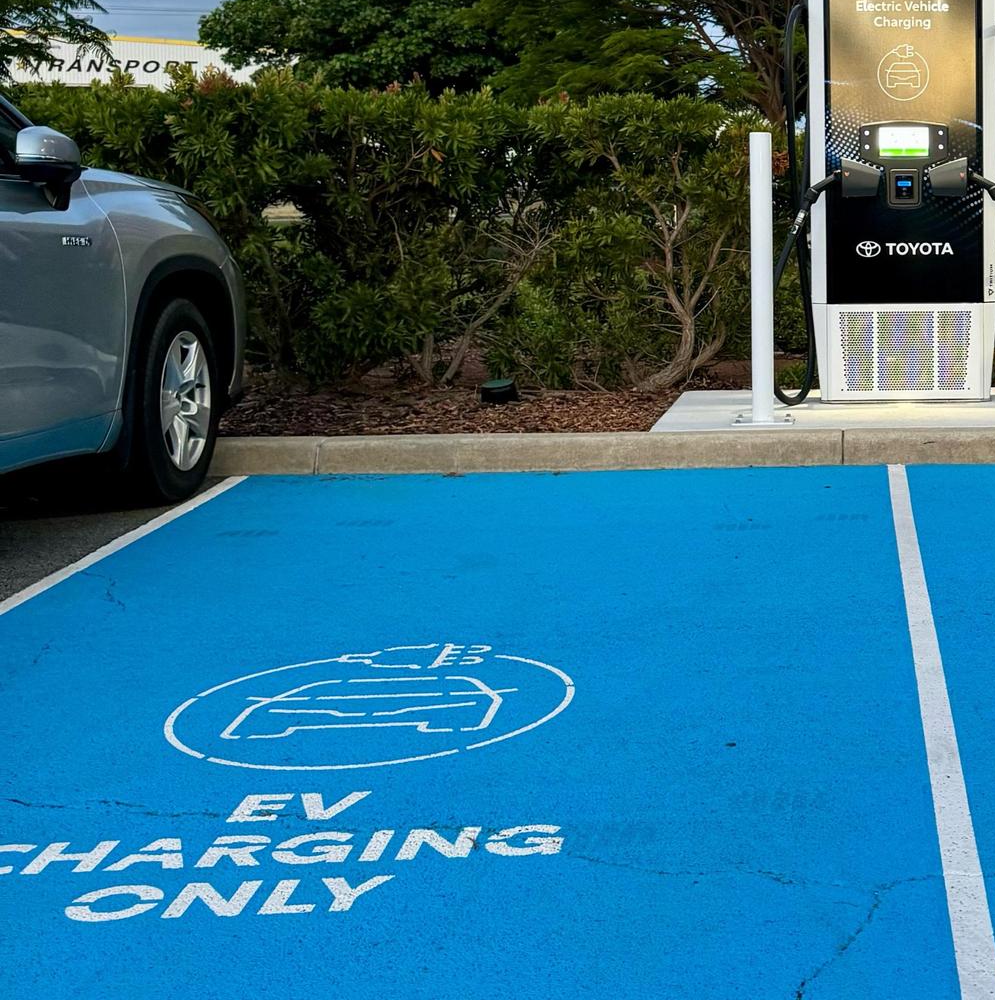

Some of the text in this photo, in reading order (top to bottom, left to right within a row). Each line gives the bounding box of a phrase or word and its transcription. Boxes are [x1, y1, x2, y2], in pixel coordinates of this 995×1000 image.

[855, 0, 950, 12] Electric Vehicle
[873, 16, 932, 30] Charging
[885, 242, 954, 256] TOYOTA
[225, 790, 372, 823] EV
[64, 874, 396, 923] ONLY
